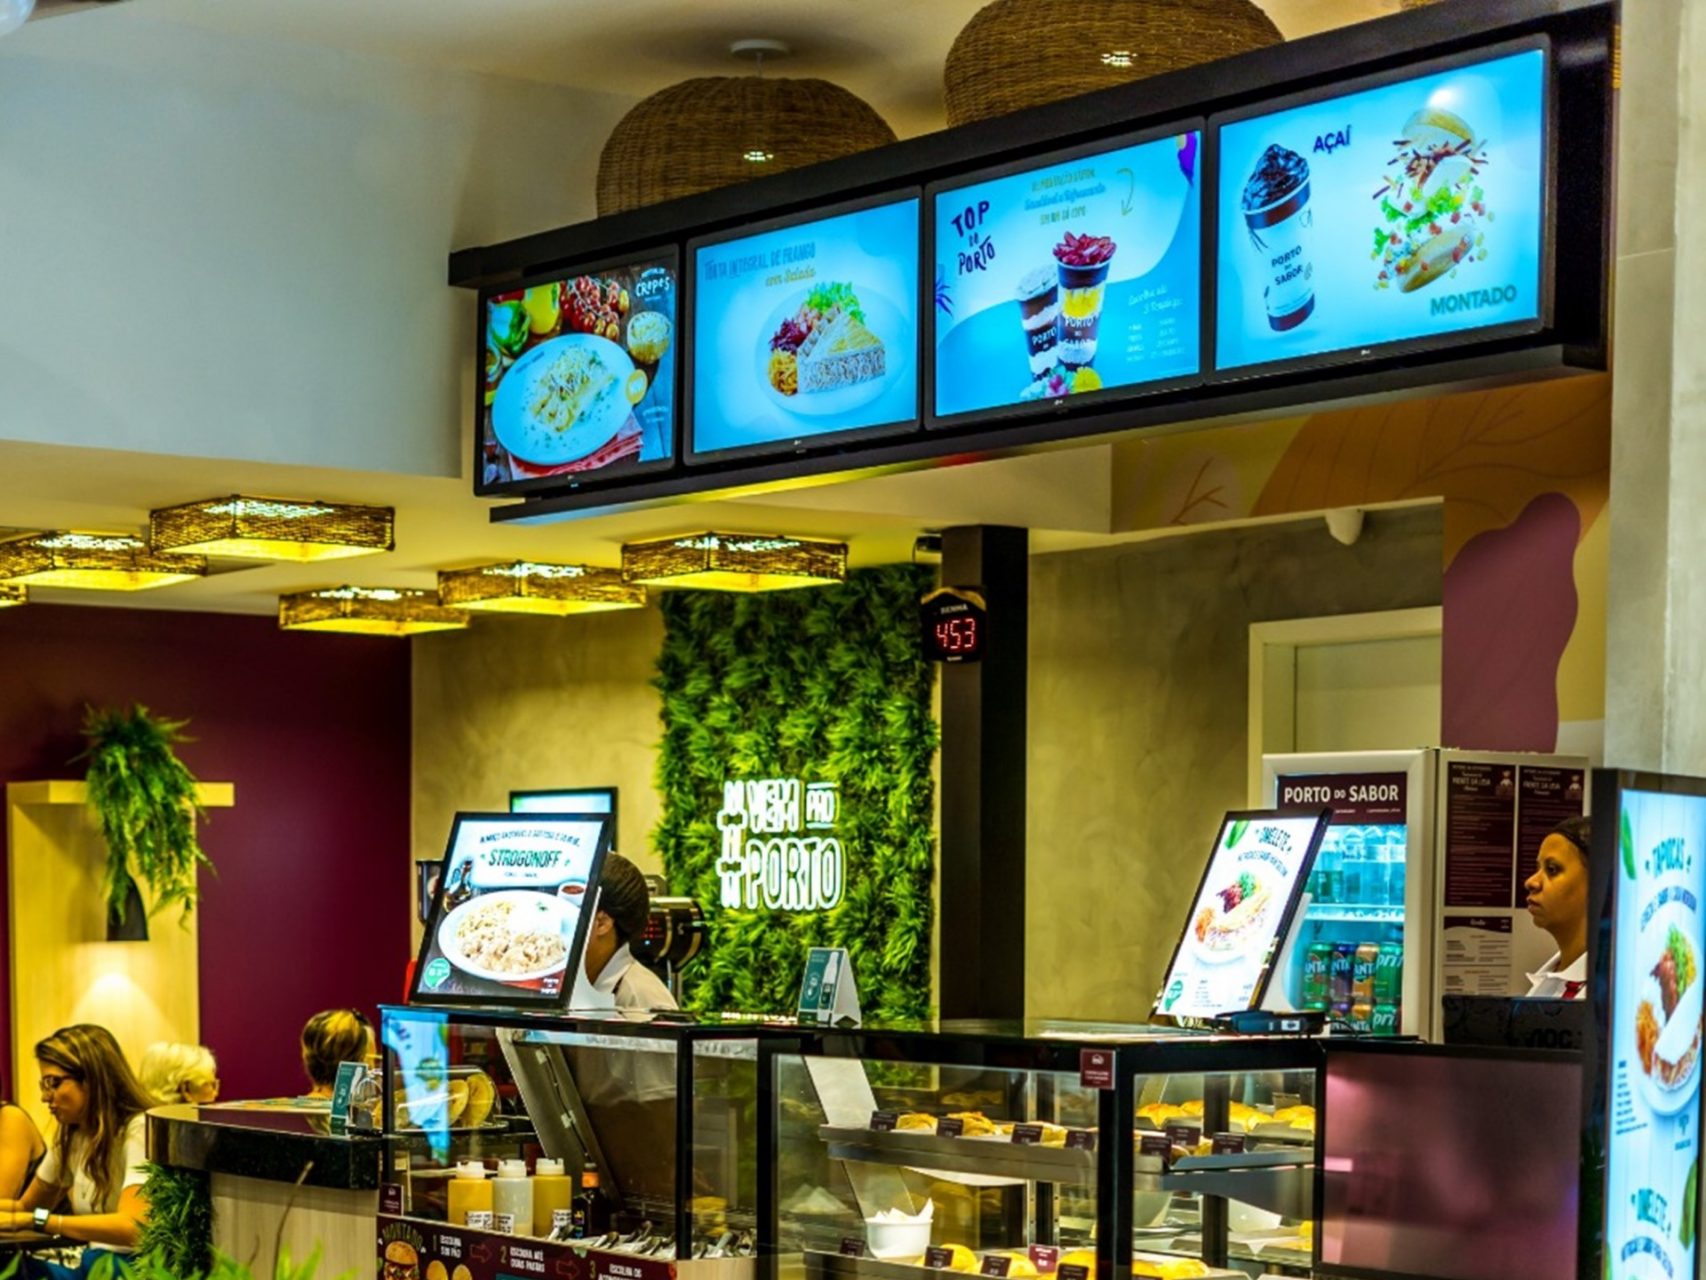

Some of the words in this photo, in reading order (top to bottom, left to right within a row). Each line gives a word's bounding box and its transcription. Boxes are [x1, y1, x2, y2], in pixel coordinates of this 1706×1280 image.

[951, 200, 990, 238] TOP
[958, 235, 995, 275] PORTO
[1271, 245, 1302, 268] PORTO
[1430, 285, 1517, 316] MONTADO
[937, 618, 976, 649] 453
[1284, 786, 1331, 803] PORTO
[1334, 790, 1346, 799] DO
[1349, 785, 1399, 802] SABOR
[489, 848, 562, 868] STROGONOFF
[746, 837, 842, 910] PORTO
[500, 1245, 508, 1264] 2
[589, 1260, 596, 1280] 3
